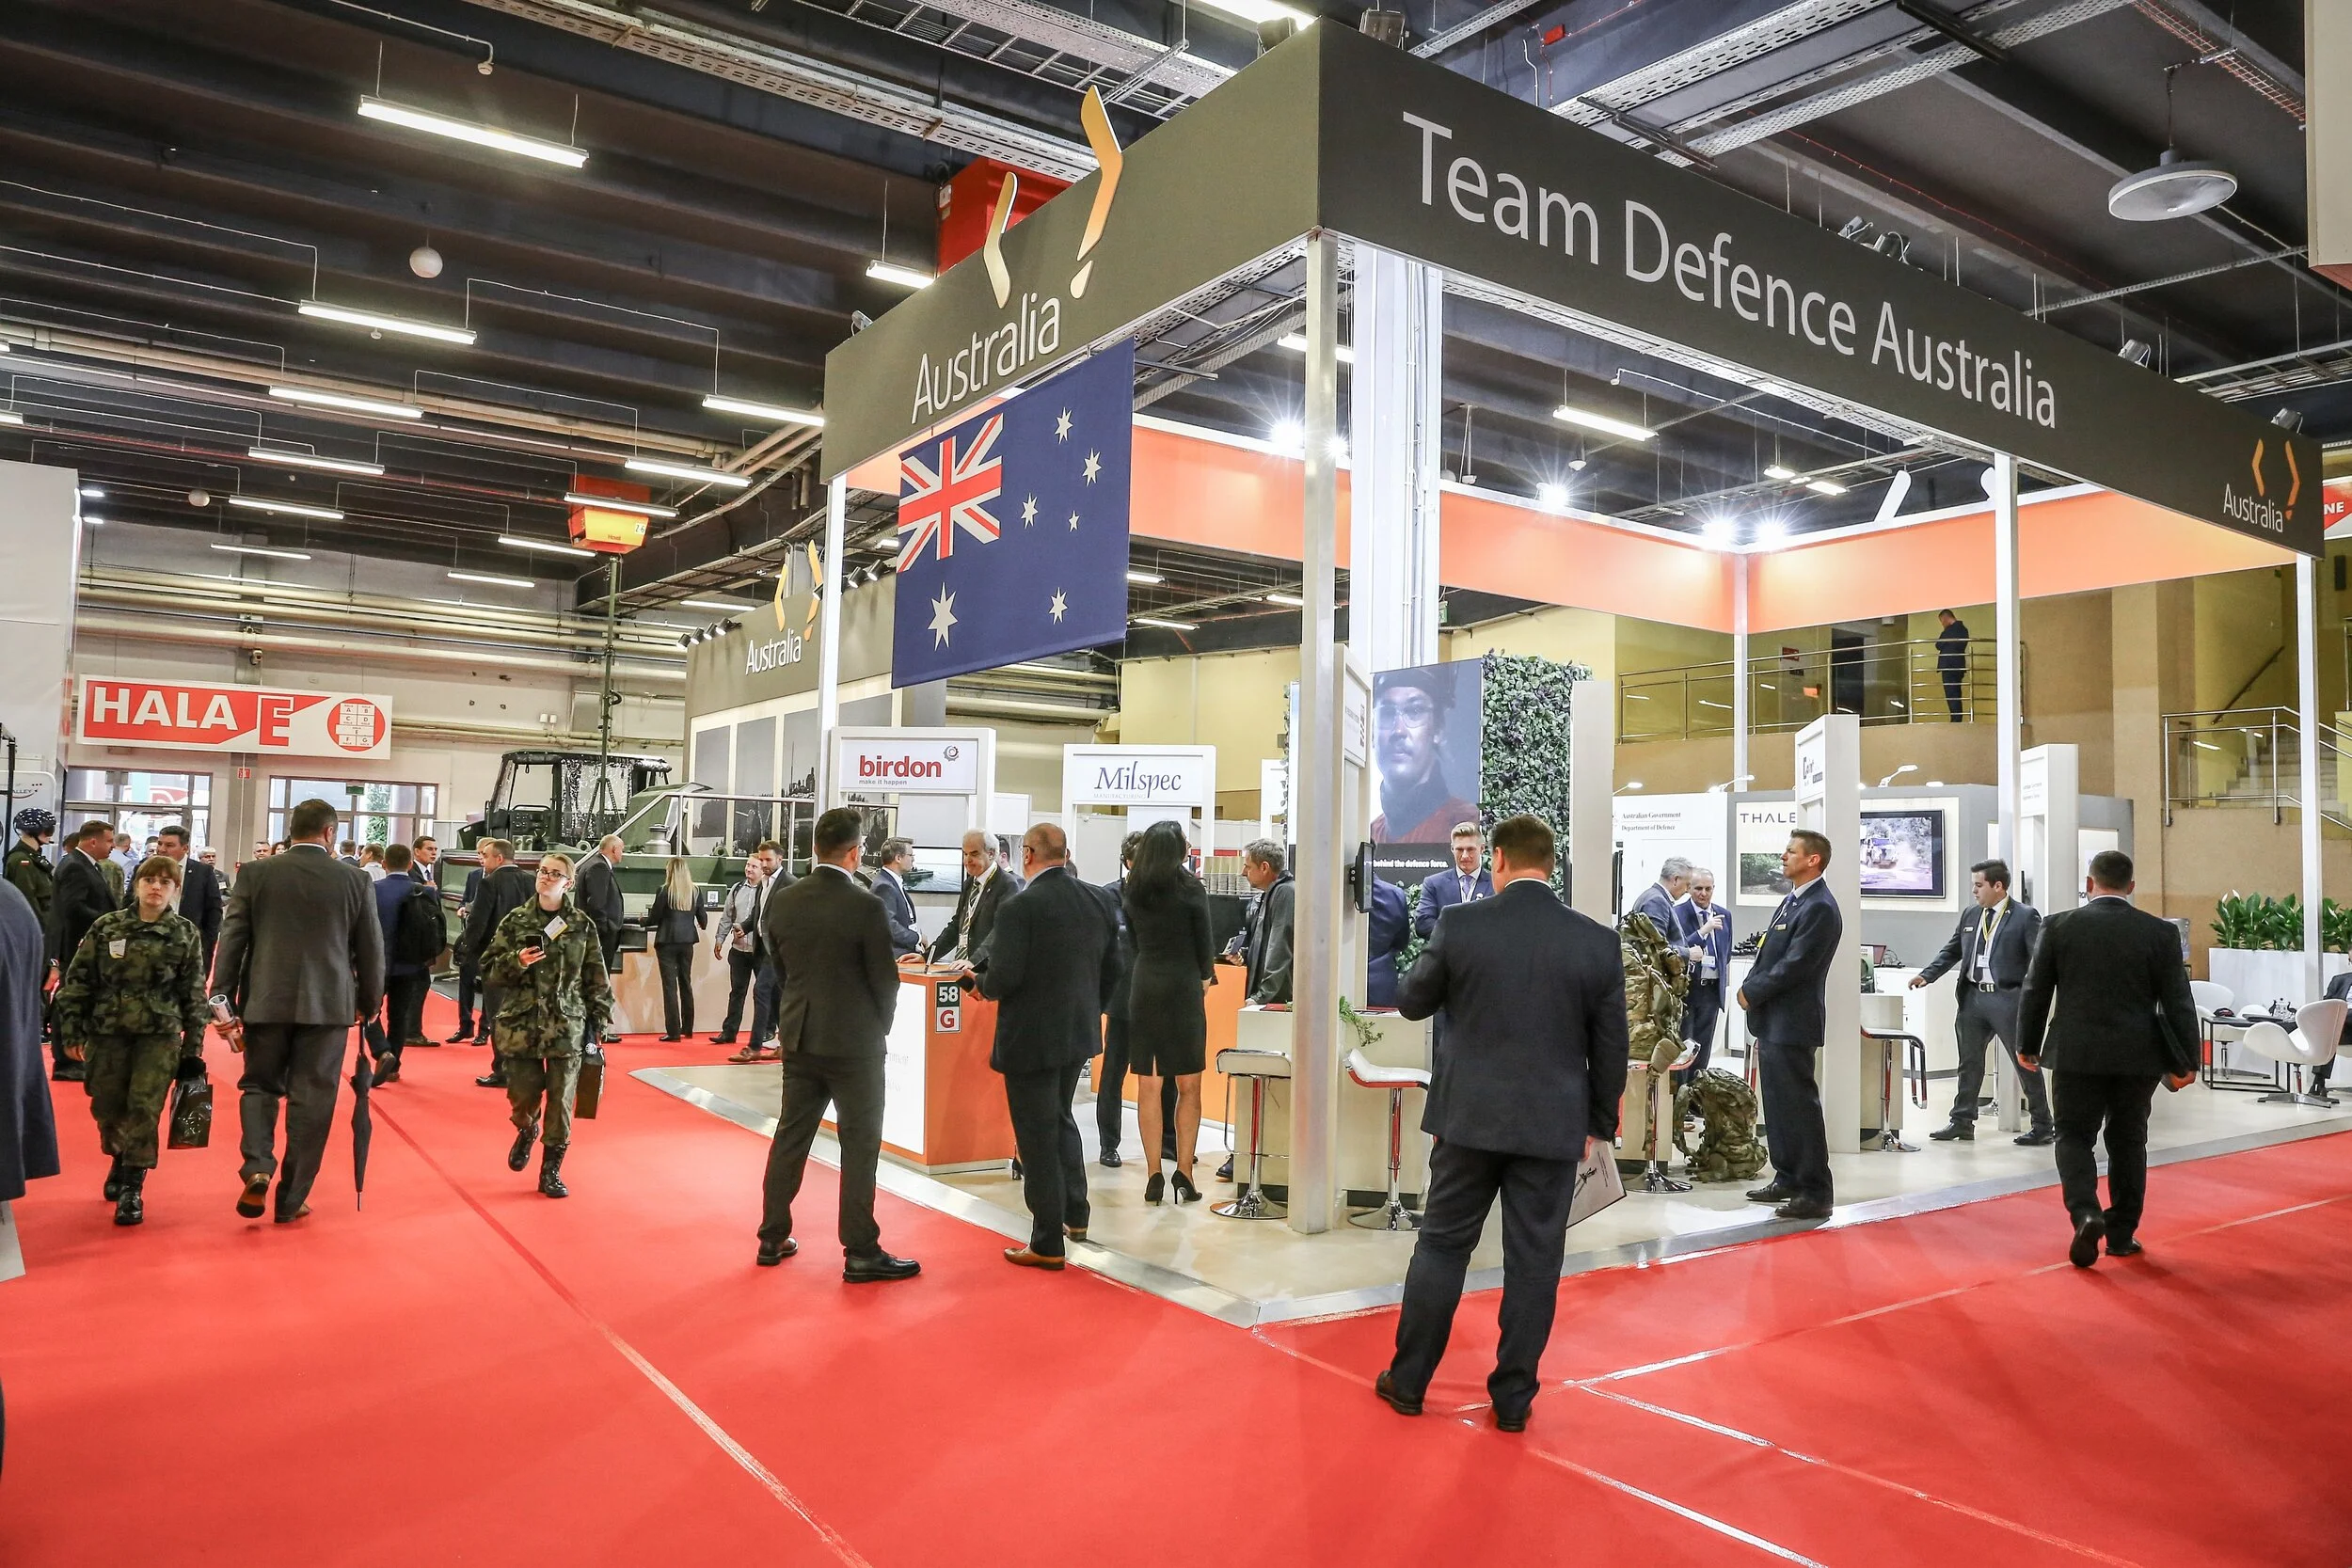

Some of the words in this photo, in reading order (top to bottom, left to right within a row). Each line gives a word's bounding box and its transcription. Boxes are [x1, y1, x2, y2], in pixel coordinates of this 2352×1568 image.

[1403, 111, 1598, 265] Team
[1626, 199, 1856, 356] Defence
[1871, 301, 2056, 429] Australia
[912, 293, 1062, 424] Australia
[2223, 483, 2283, 533] Australia
[2324, 501, 2344, 515] NE
[745, 627, 802, 675] Australia
[93, 686, 238, 731] HALA
[257, 694, 294, 747] E
[859, 755, 942, 778] birdon
[1093, 760, 1182, 799] Milspec
[1740, 813, 1796, 823] THALE
[1394, 858, 1405, 868] the
[1405, 858, 1430, 868] defence
[938, 986, 959, 1003] 58
[940, 1009, 955, 1029] G
